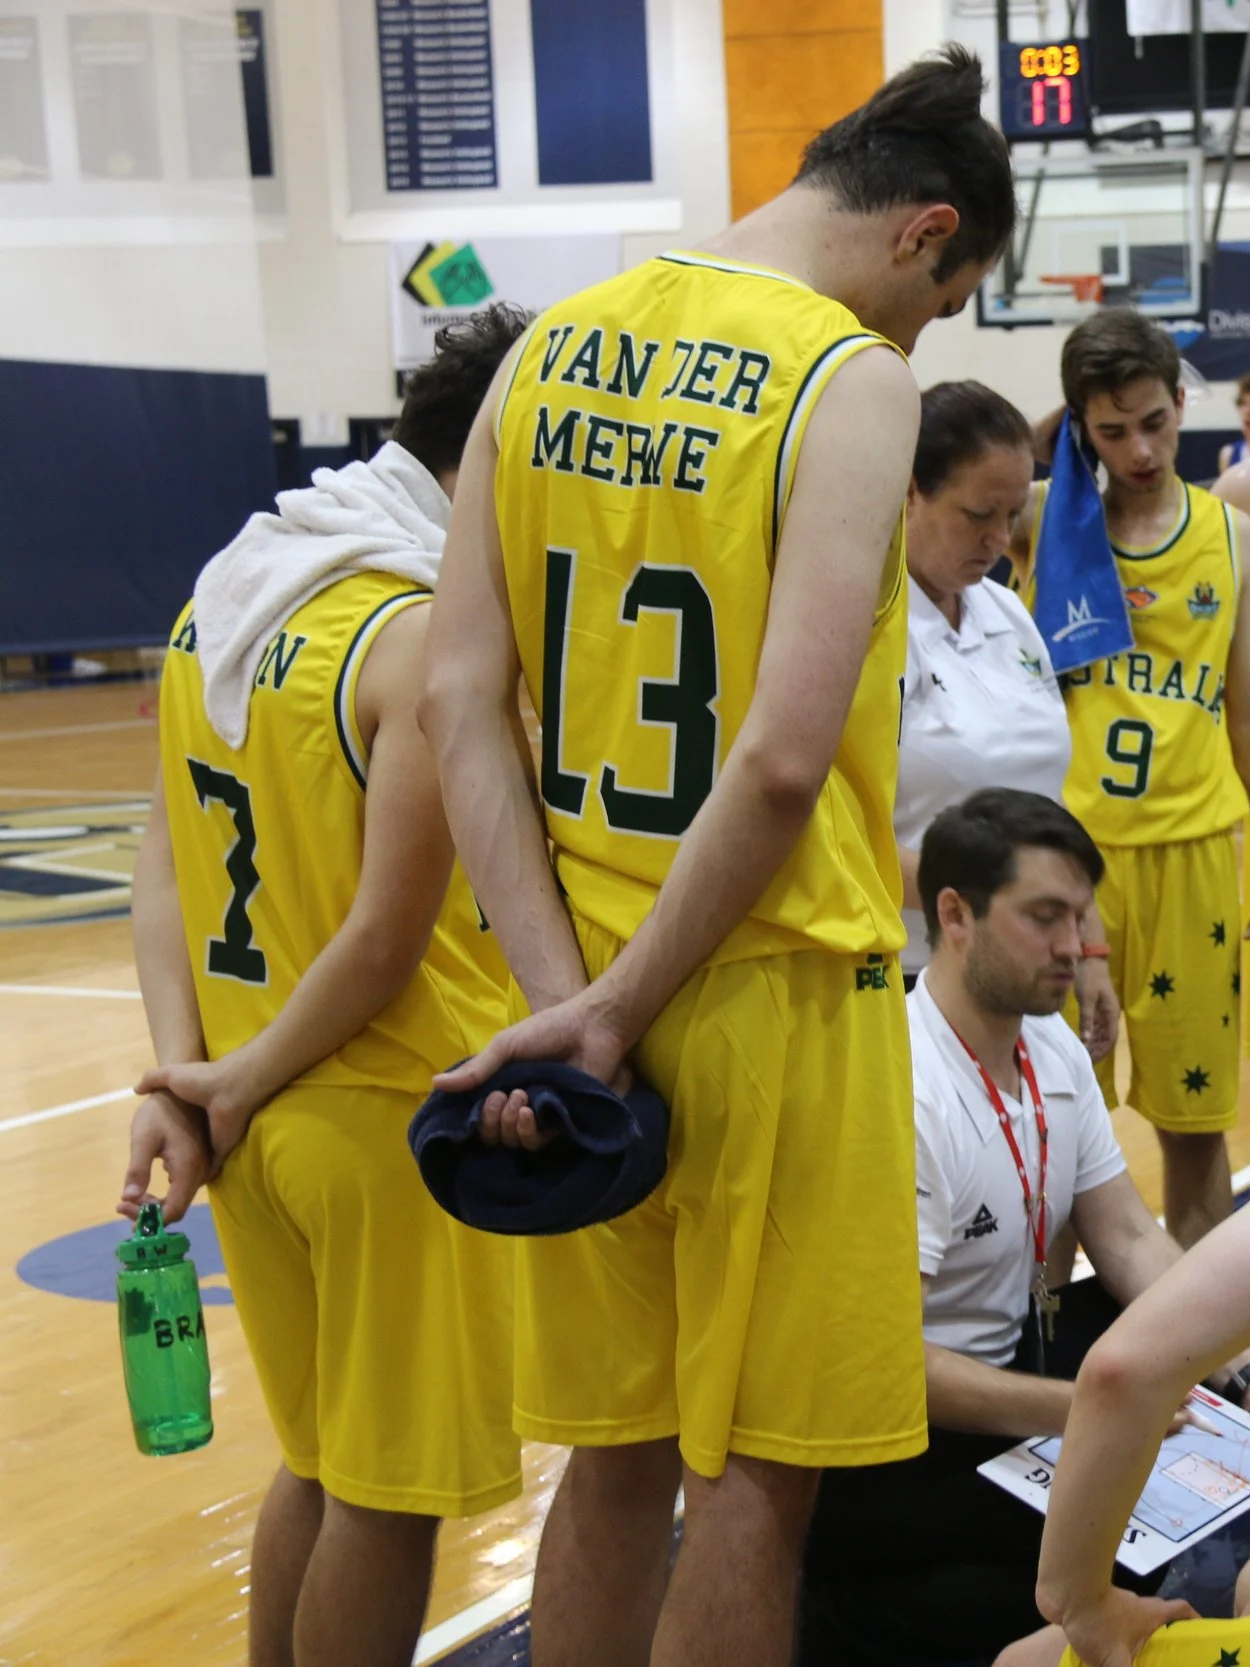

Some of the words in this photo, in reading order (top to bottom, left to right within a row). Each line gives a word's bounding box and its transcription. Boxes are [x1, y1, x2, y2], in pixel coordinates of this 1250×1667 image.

[1020, 45, 1079, 78] 0:03
[1031, 76, 1072, 126] 17
[539, 325, 660, 400] VAN
[541, 546, 719, 838] 13
[1101, 718, 1155, 799] 9
